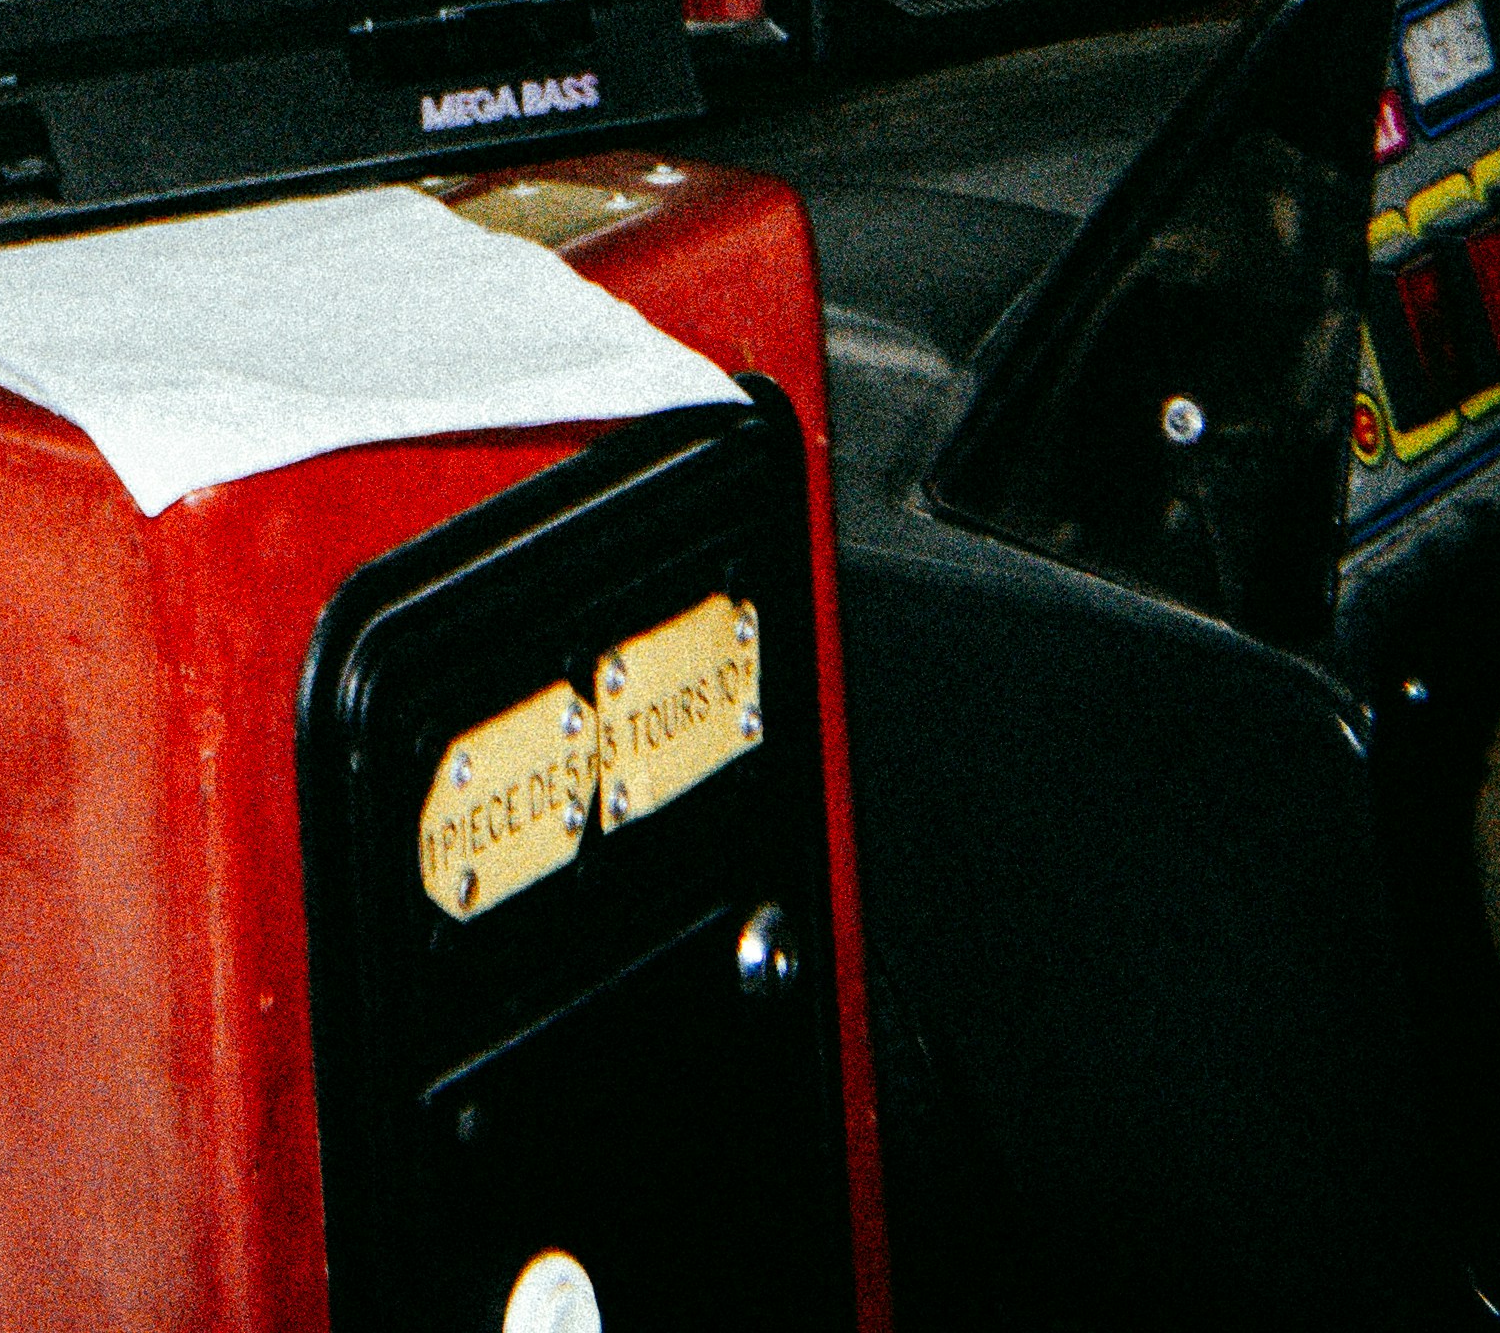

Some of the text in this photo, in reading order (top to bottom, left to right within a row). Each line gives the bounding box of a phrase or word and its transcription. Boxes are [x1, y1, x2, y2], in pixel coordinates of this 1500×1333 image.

[420, 71, 601, 132] MEGA BASS
[628, 677, 709, 755] TOURS
[442, 784, 521, 872] PIECE
